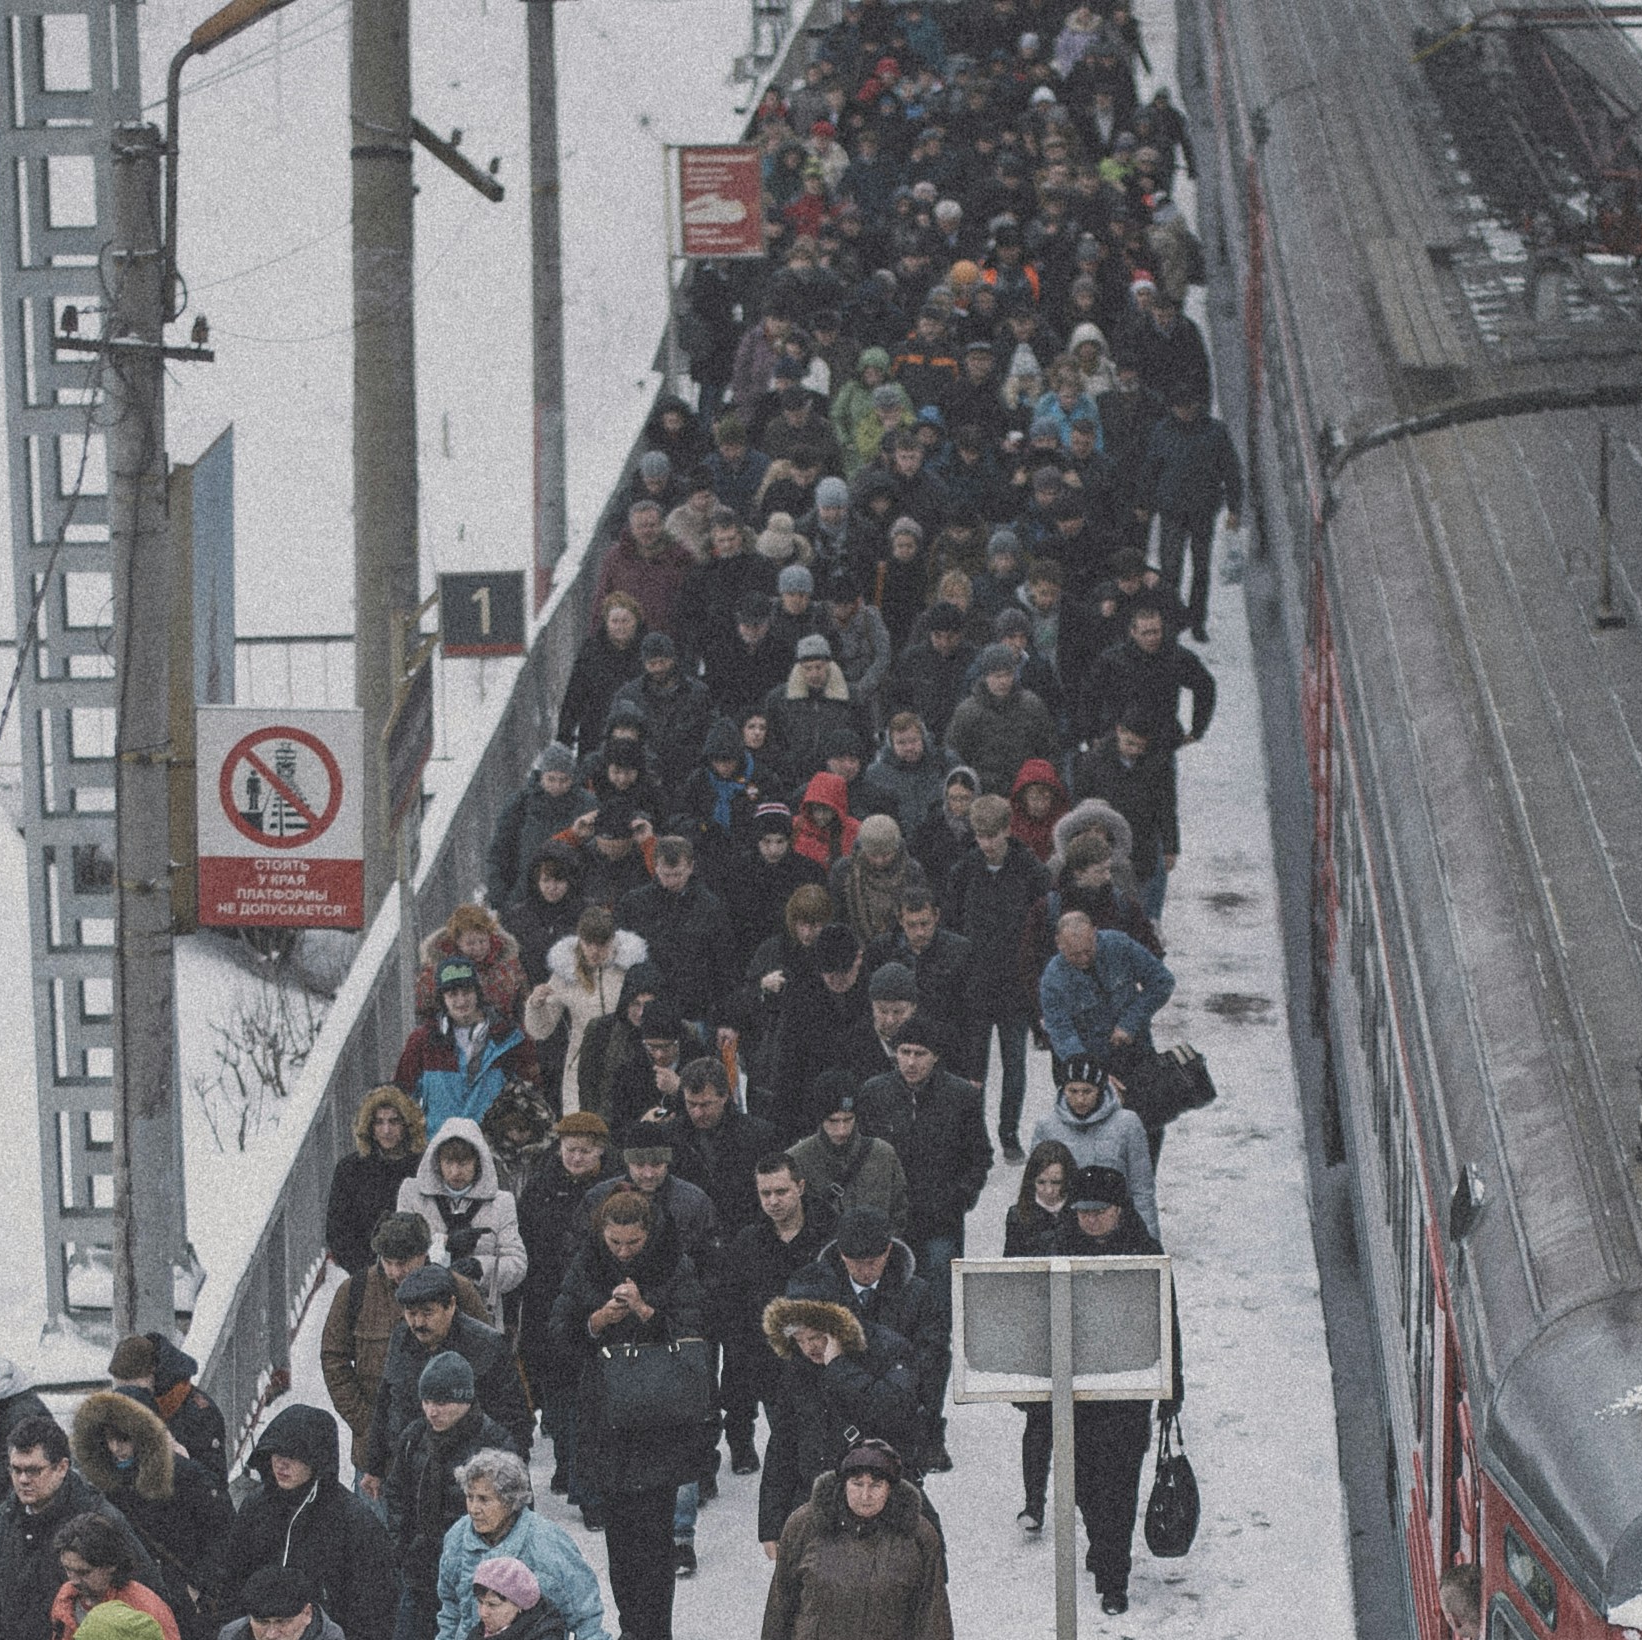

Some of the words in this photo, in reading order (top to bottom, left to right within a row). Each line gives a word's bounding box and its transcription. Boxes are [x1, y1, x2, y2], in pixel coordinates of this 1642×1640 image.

[471, 586, 491, 635] 1
[255, 859, 310, 872] СТОЯТЬ
[259, 875, 266, 885] У
[271, 875, 306, 886] КРАЯ
[237, 889, 328, 901] ПЛАТФОРМЫ
[218, 902, 236, 915] НЕ
[240, 903, 346, 916] ДОПУСКАЕТСЯ!
